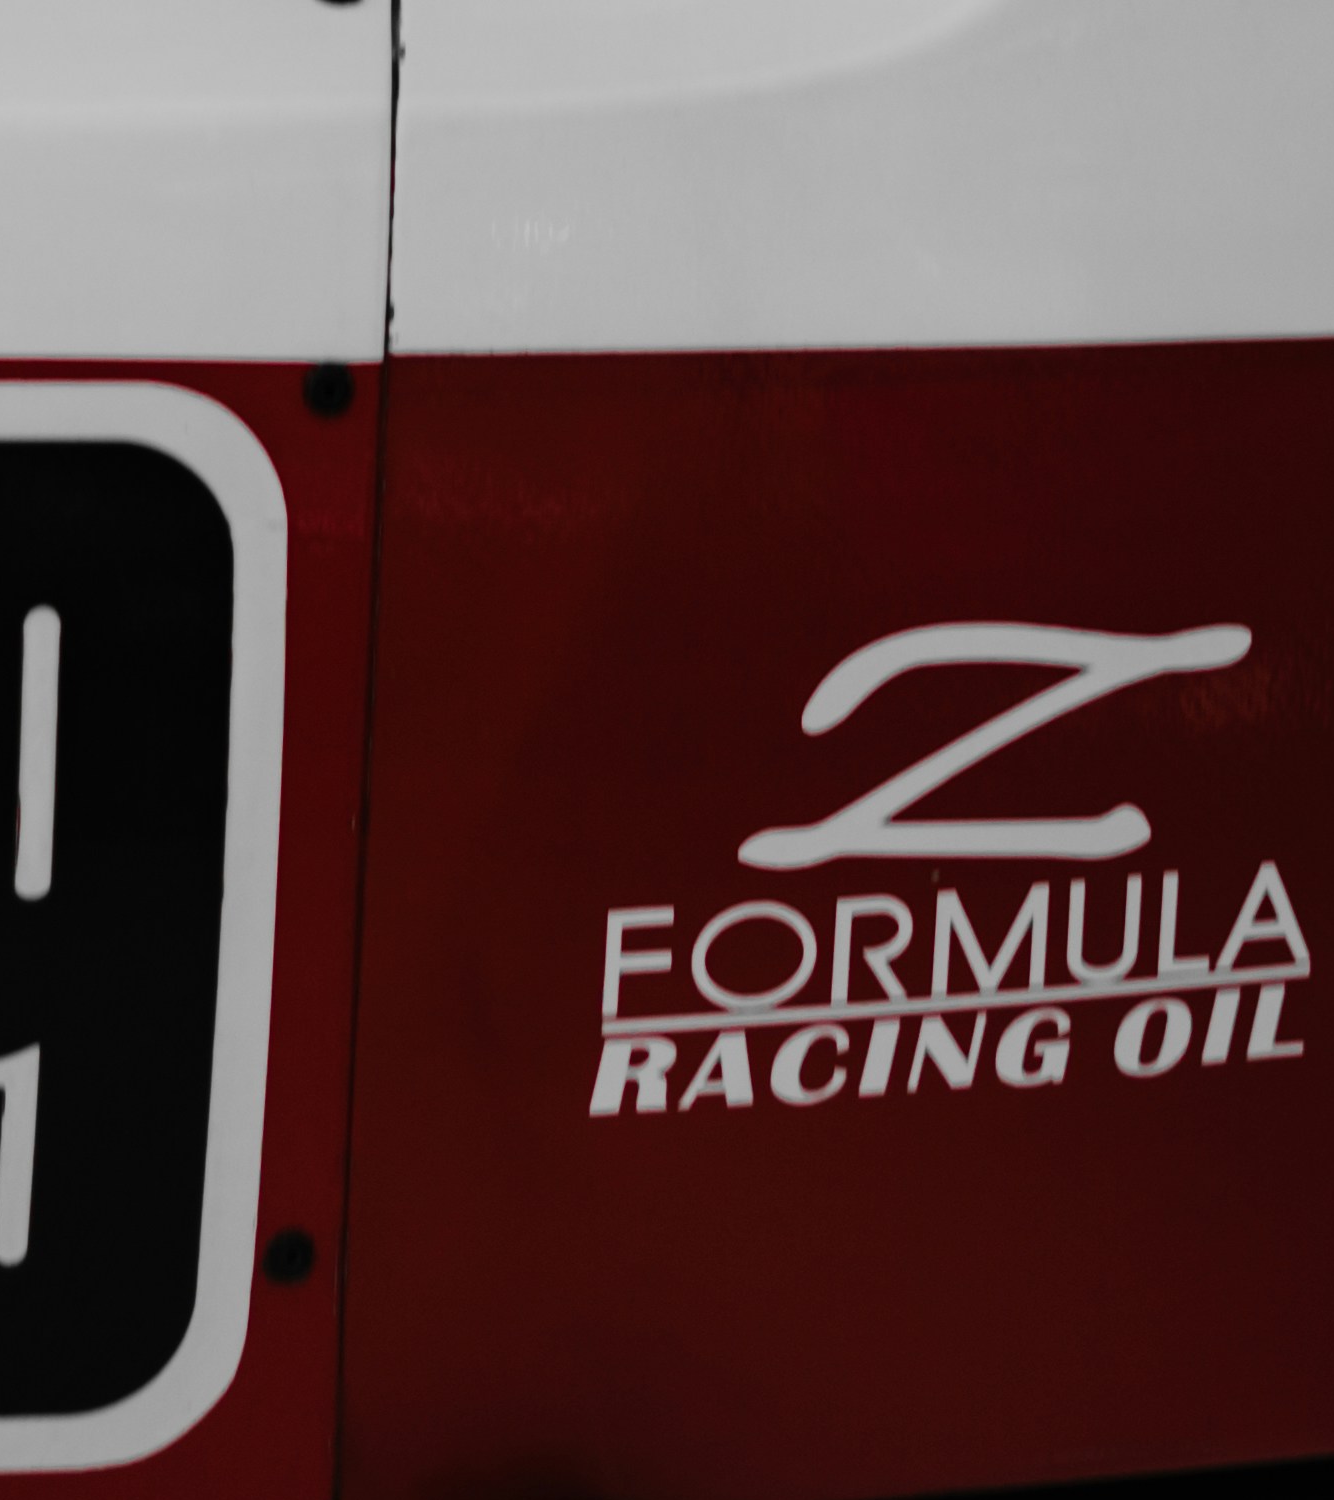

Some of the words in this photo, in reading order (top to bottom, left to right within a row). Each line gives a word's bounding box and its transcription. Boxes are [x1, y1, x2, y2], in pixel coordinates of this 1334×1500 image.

[737, 620, 1253, 870] Z
[600, 860, 1311, 1022] FORMULA
[588, 1004, 1072, 1118] RACING
[1113, 981, 1305, 1078] OIL
